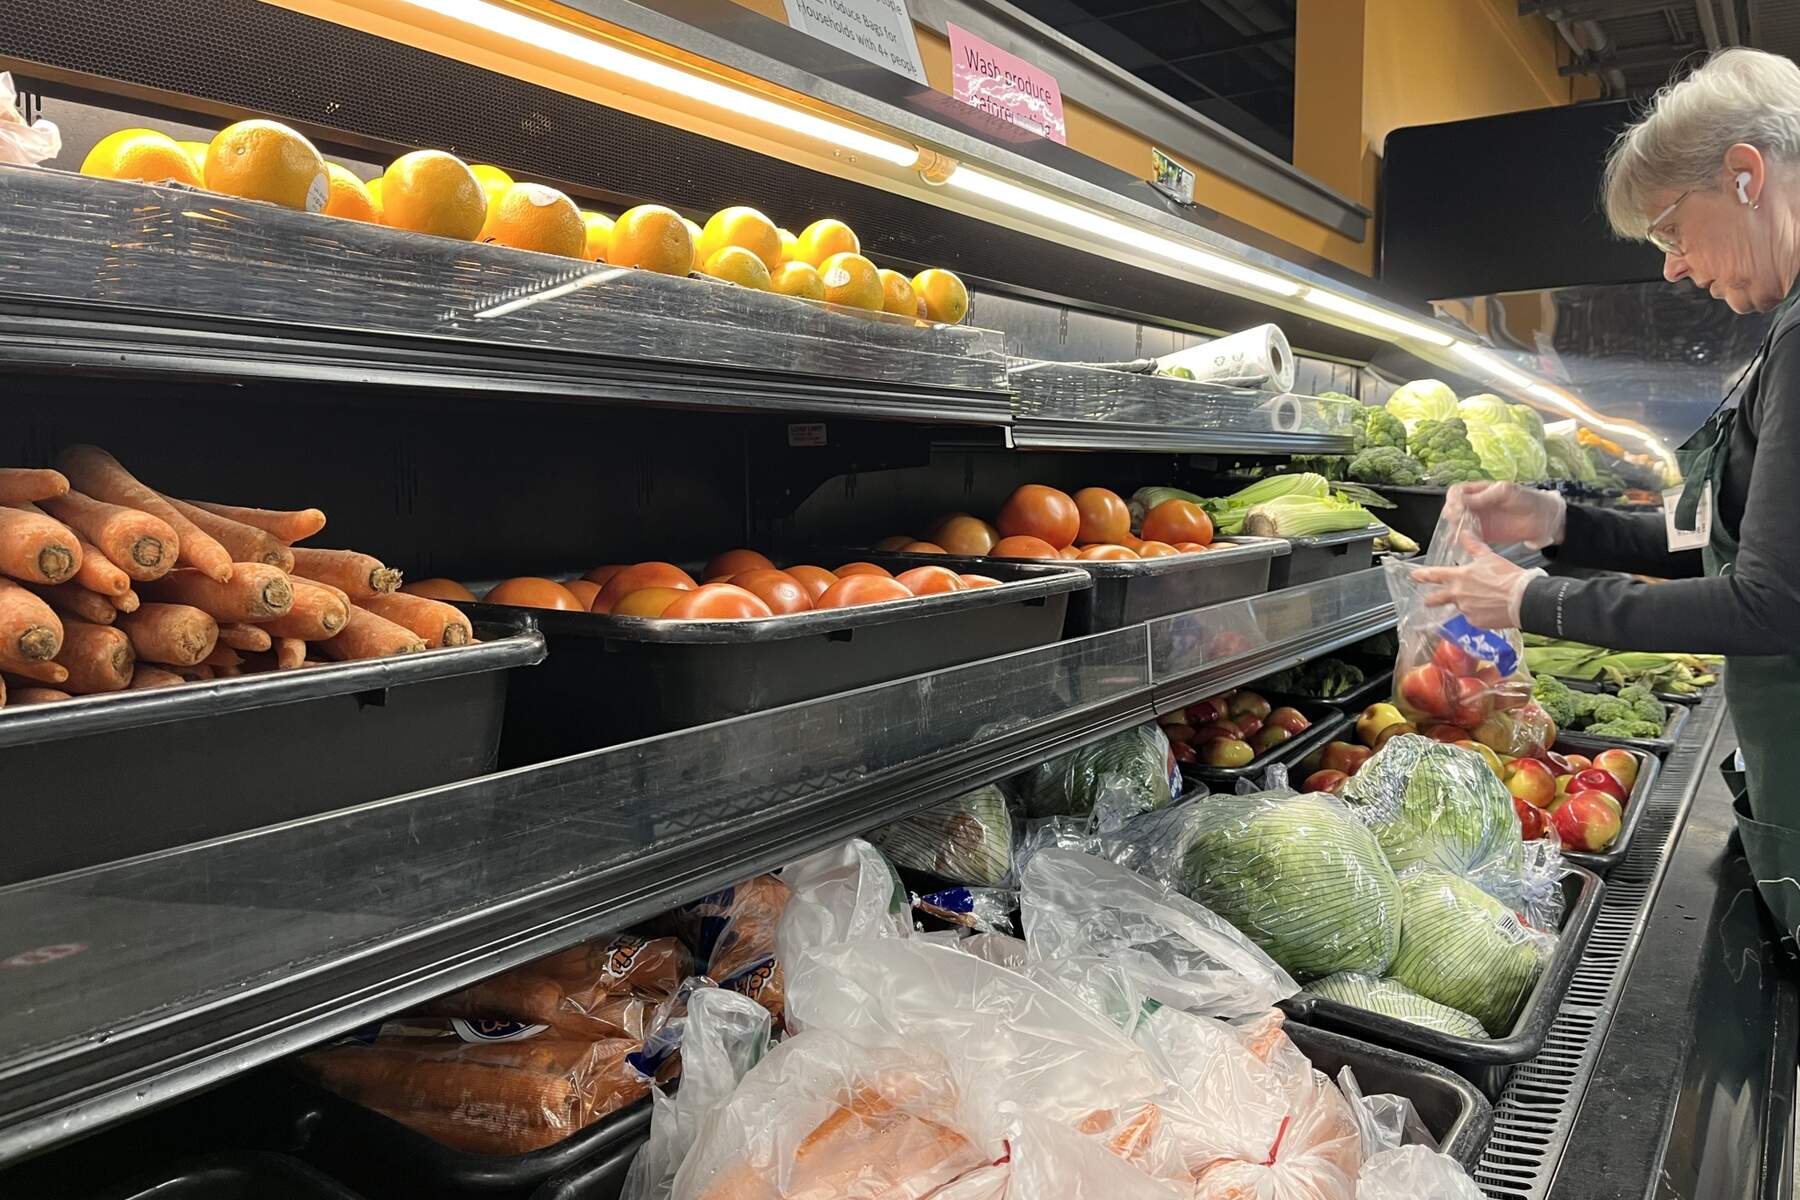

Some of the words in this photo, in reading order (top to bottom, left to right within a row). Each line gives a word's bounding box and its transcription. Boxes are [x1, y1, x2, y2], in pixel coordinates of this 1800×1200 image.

[796, 0, 855, 41] Households
[855, 33, 877, 53] with
[825, 0, 862, 24] roduce
[862, 14, 884, 37] Bags
[883, 26, 897, 43] for
[964, 45, 1001, 78] Wash
[1004, 70, 1052, 106] produce
